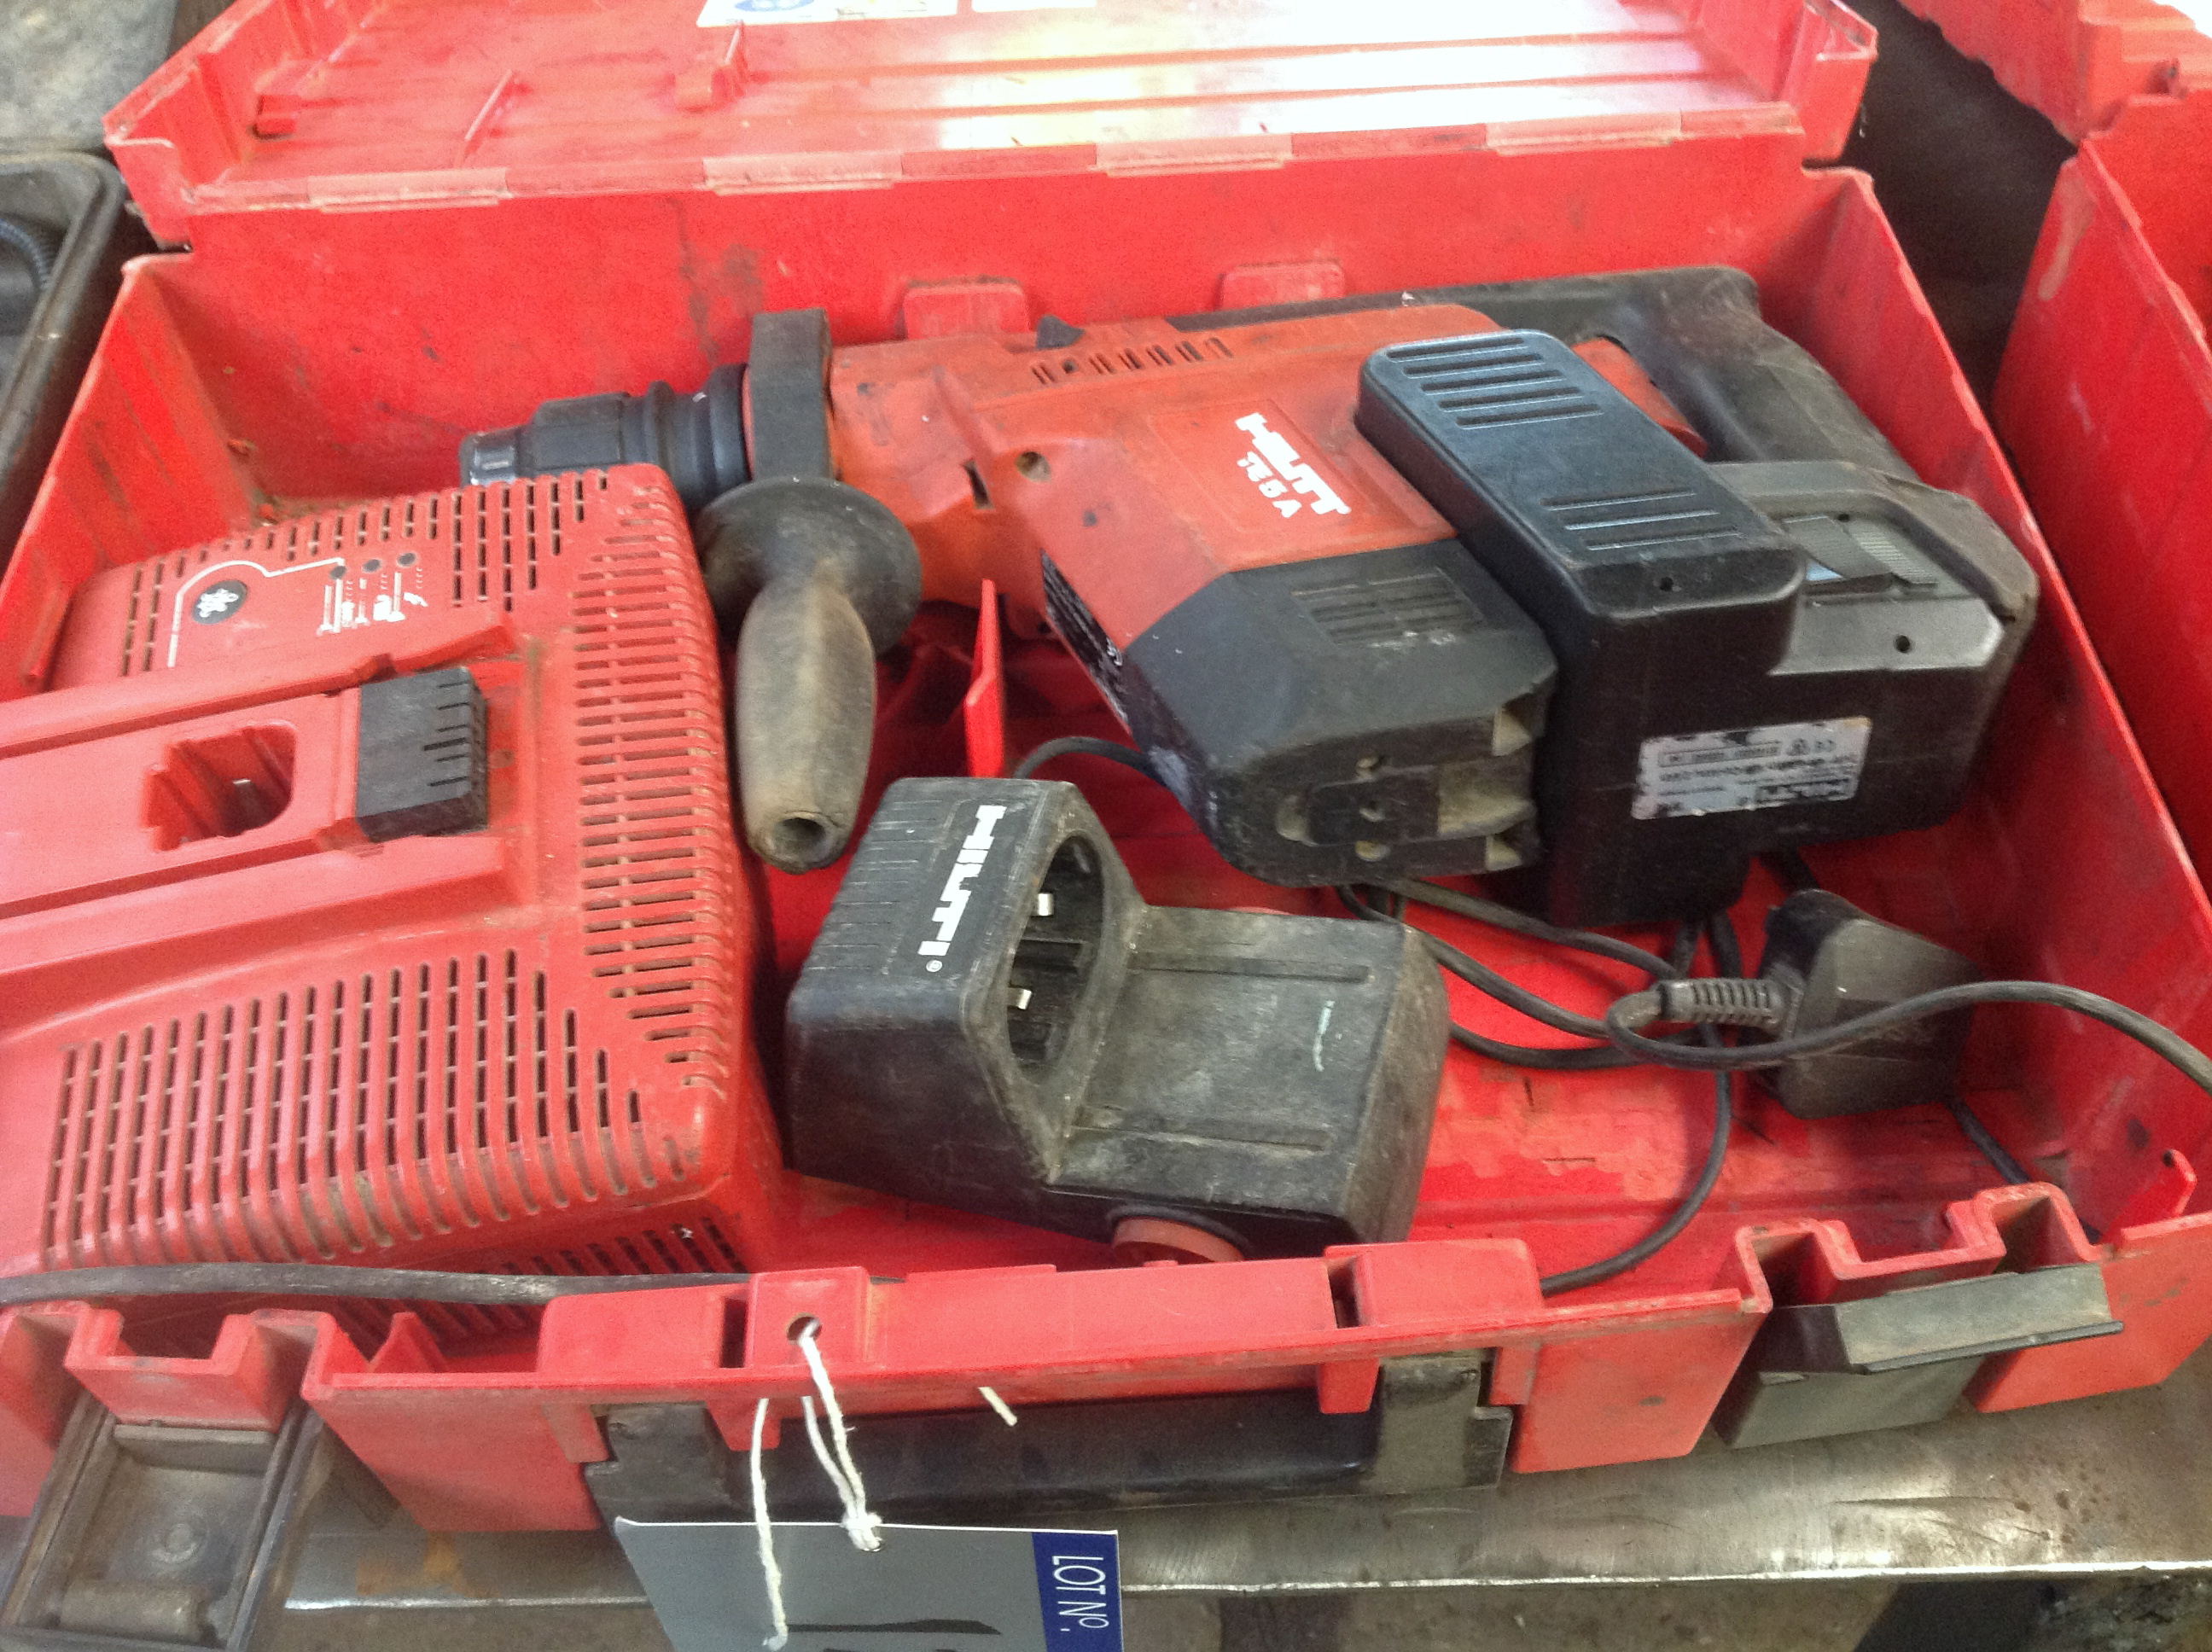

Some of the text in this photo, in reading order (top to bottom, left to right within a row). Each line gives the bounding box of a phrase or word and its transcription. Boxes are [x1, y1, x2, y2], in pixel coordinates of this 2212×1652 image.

[1235, 412, 1349, 515] HILTI
[917, 805, 1008, 957] HILTI
[1051, 1556, 1106, 1596] LOT
